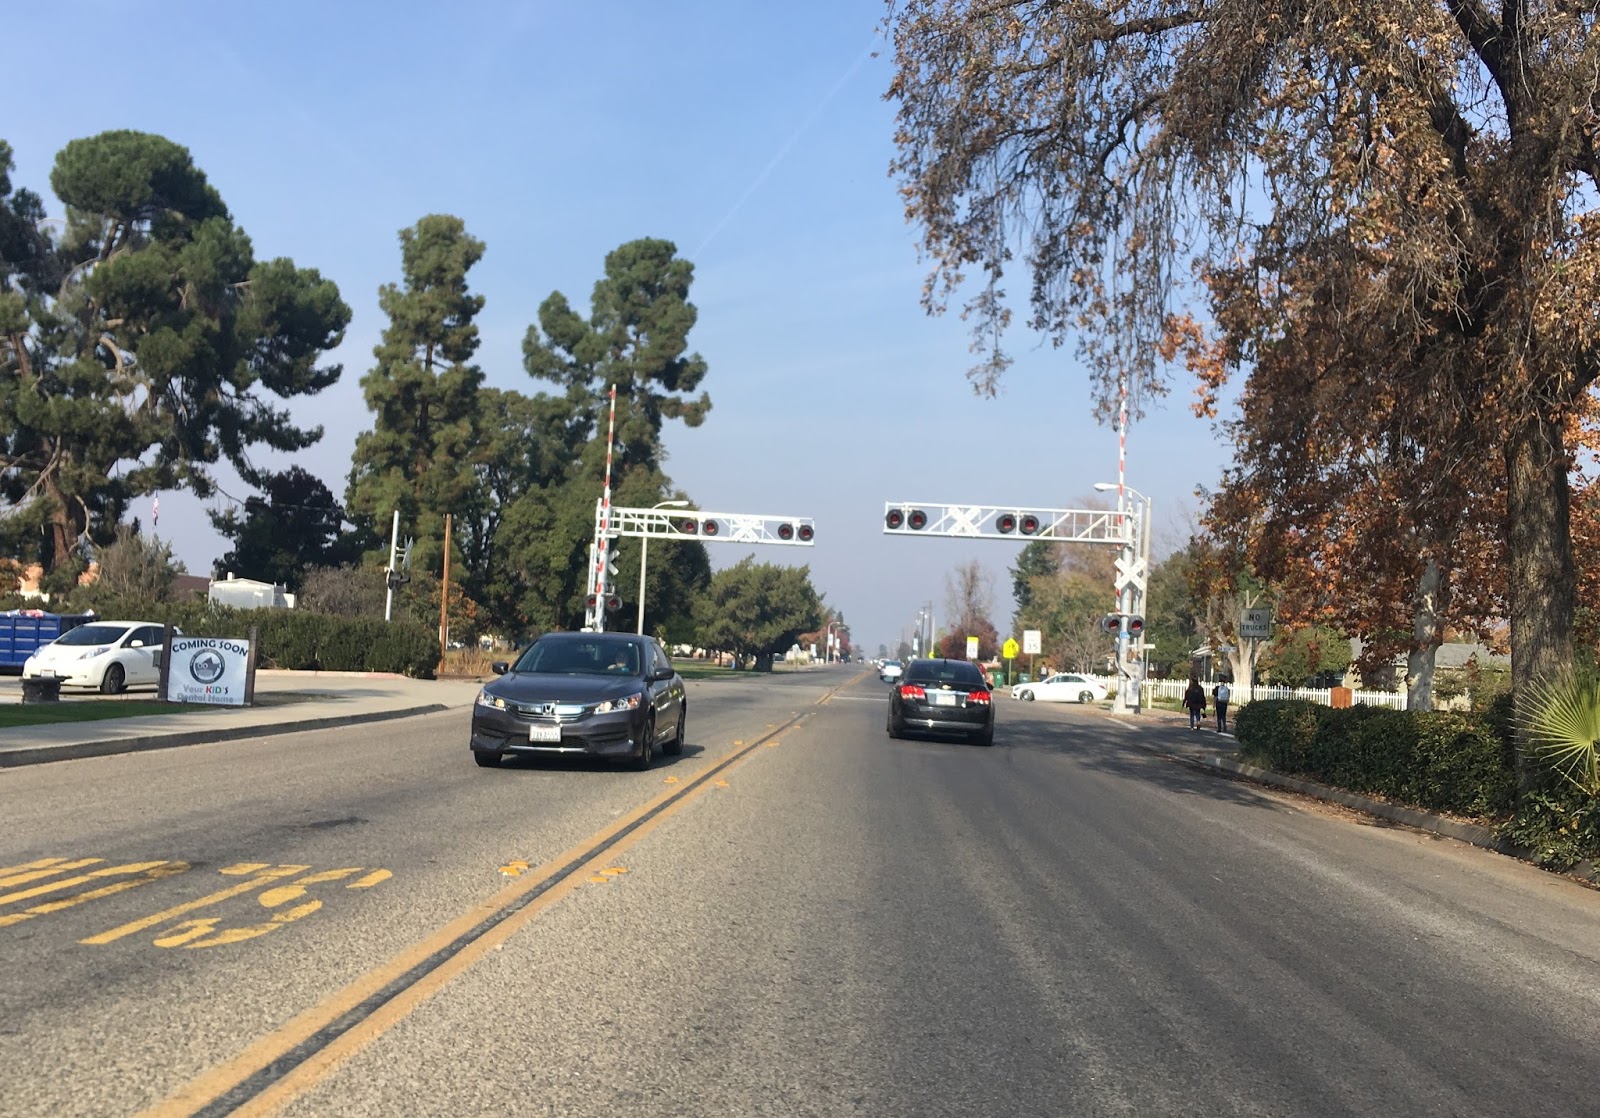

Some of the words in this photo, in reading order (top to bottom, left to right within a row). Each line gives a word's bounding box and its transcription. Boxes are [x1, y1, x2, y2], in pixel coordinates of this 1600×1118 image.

[1248, 613, 1261, 621] NO
[172, 639, 216, 652] COMING
[219, 640, 248, 656] SOON
[183, 684, 204, 694] Your
[177, 692, 206, 703] Dental
[208, 694, 234, 704] Home
